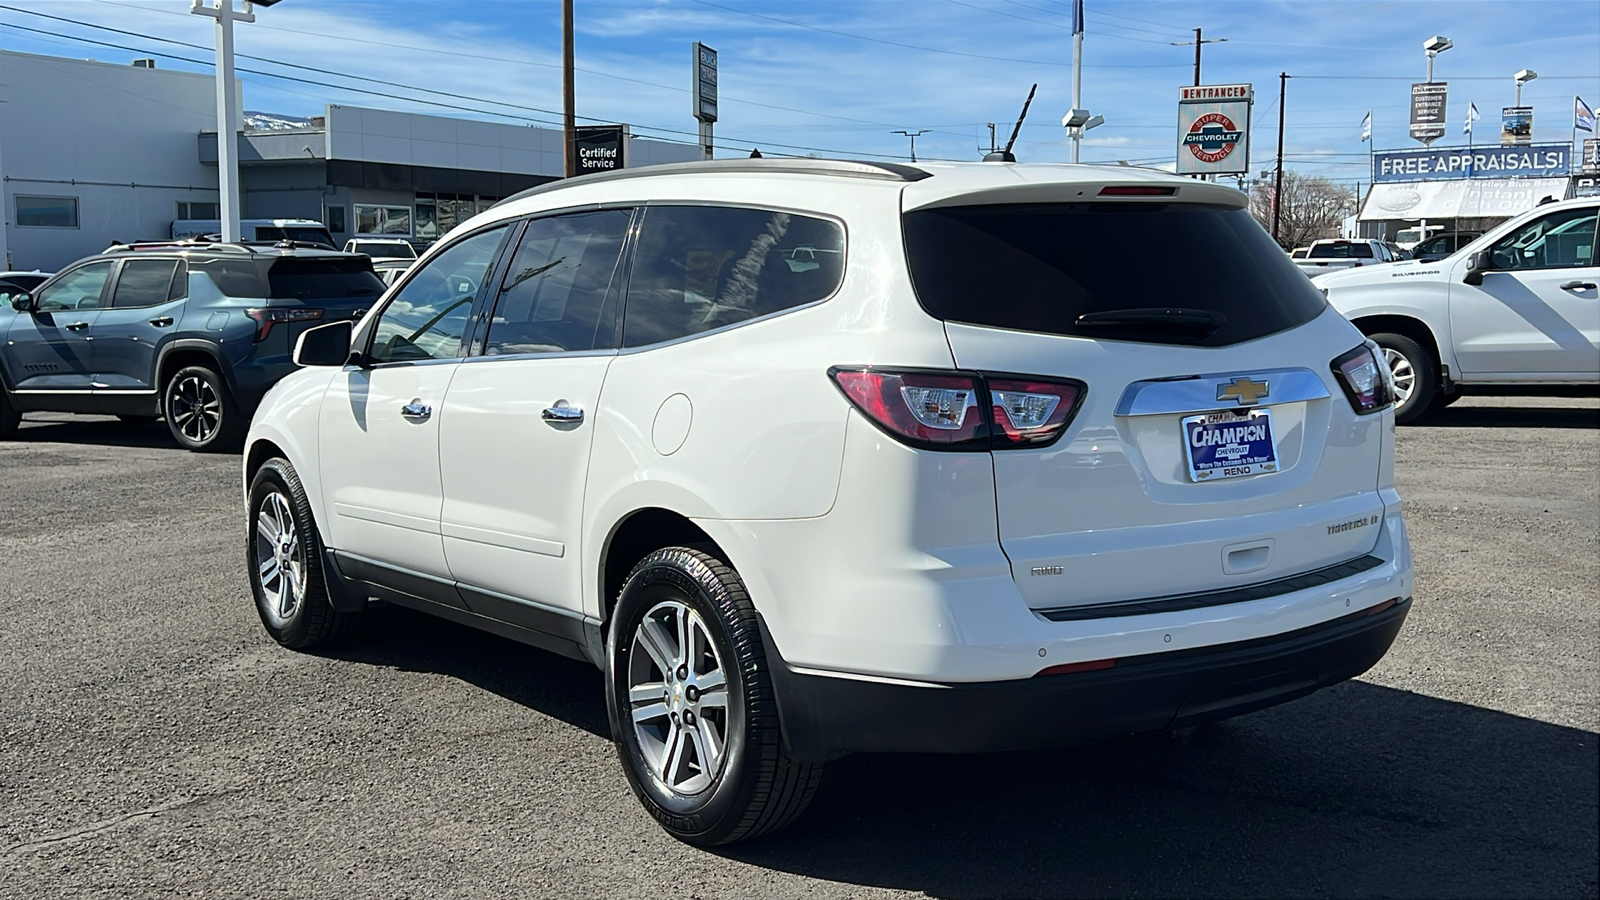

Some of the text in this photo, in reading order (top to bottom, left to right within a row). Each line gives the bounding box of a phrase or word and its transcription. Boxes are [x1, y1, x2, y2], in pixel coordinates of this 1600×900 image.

[1190, 87, 1239, 99] ENTRANCE
[1196, 114, 1229, 127] SUPER
[1187, 134, 1237, 142] CHEVROLET
[579, 147, 617, 158] Certified
[1192, 145, 1232, 162] SERVICE
[582, 158, 615, 168] Service
[1380, 151, 1564, 176] FREE APPRAISALS!
[1474, 180, 1507, 189] Kelley
[1508, 180, 1532, 188] Blue
[1533, 180, 1561, 188] Book
[1464, 188, 1534, 199] Instant
[1192, 425, 1265, 448] CHAMPION
[1216, 446, 1248, 456] CHEVROLET
[1223, 466, 1251, 477] RENO
